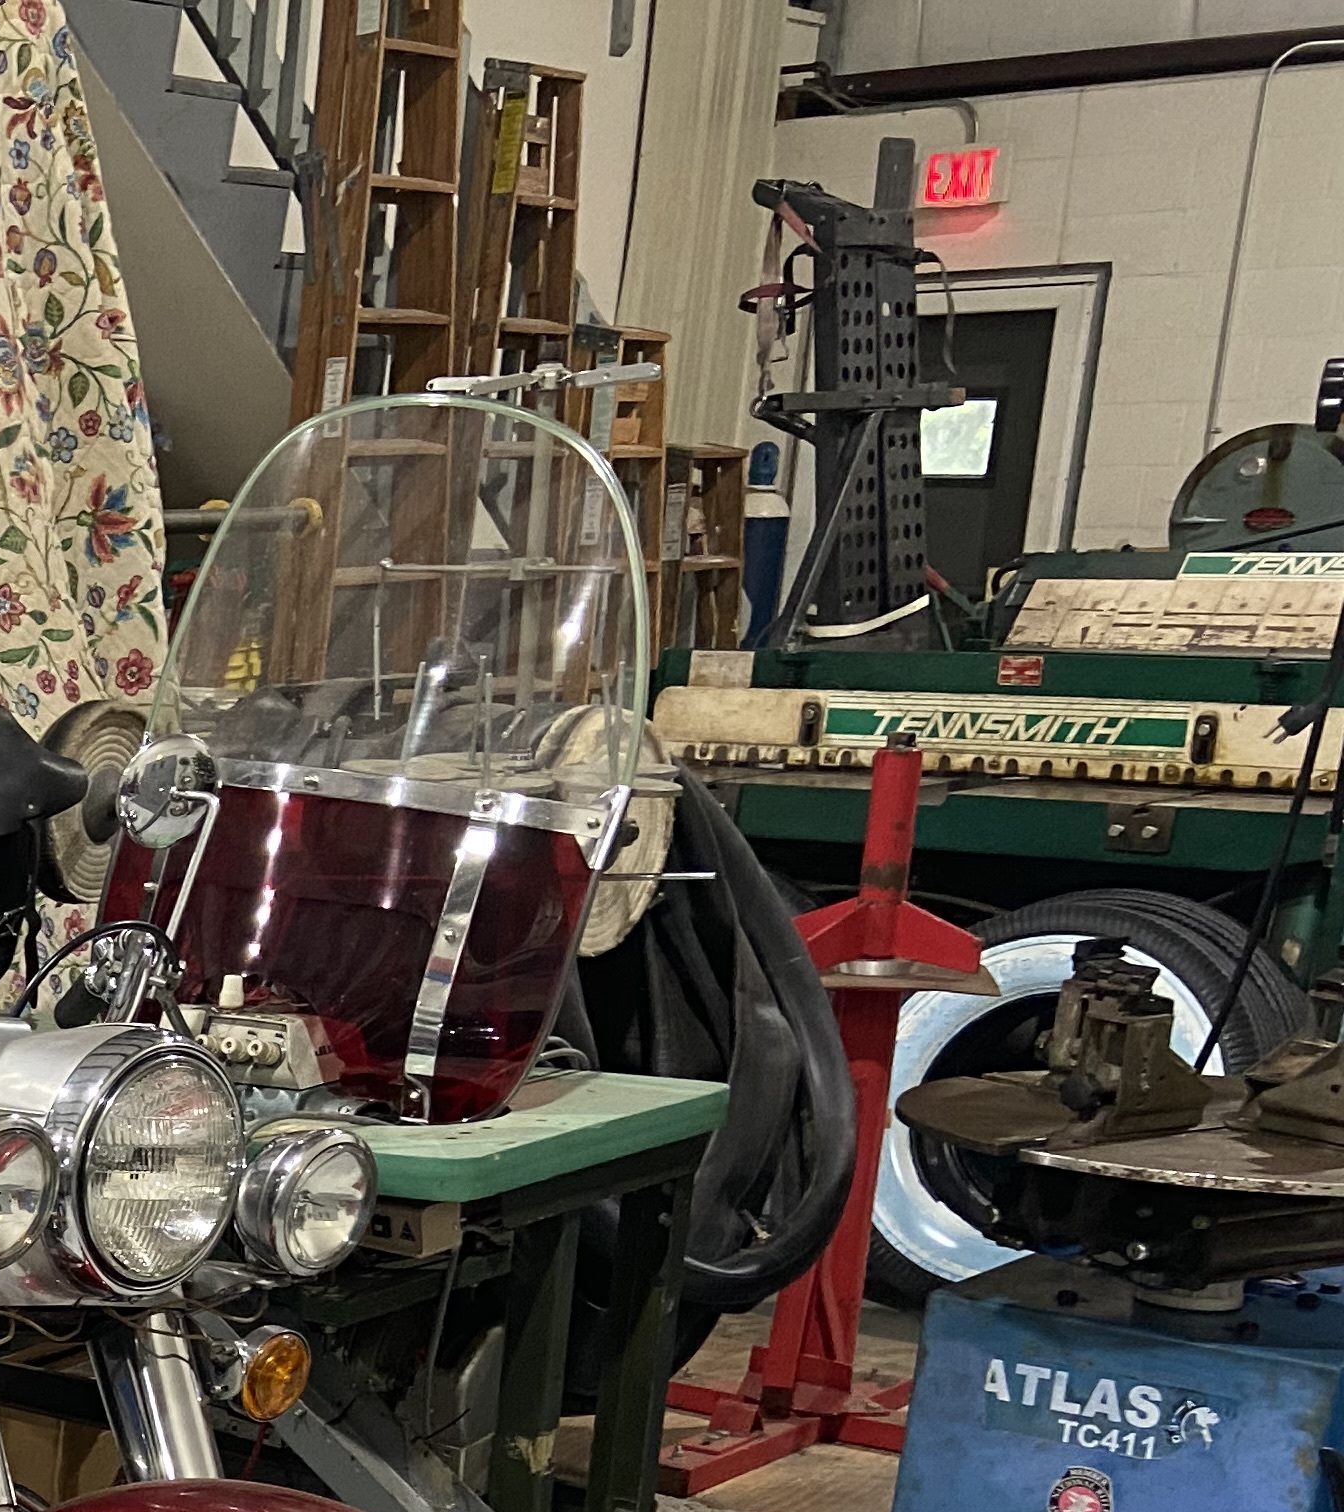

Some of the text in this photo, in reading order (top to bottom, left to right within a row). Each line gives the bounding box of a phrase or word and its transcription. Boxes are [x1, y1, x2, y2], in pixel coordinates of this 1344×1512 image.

[924, 148, 1000, 202] EXIT
[873, 709, 1128, 745] TENNSMITH
[984, 1359, 1162, 1428] ATLAS
[1058, 1419, 1156, 1459] TC411
